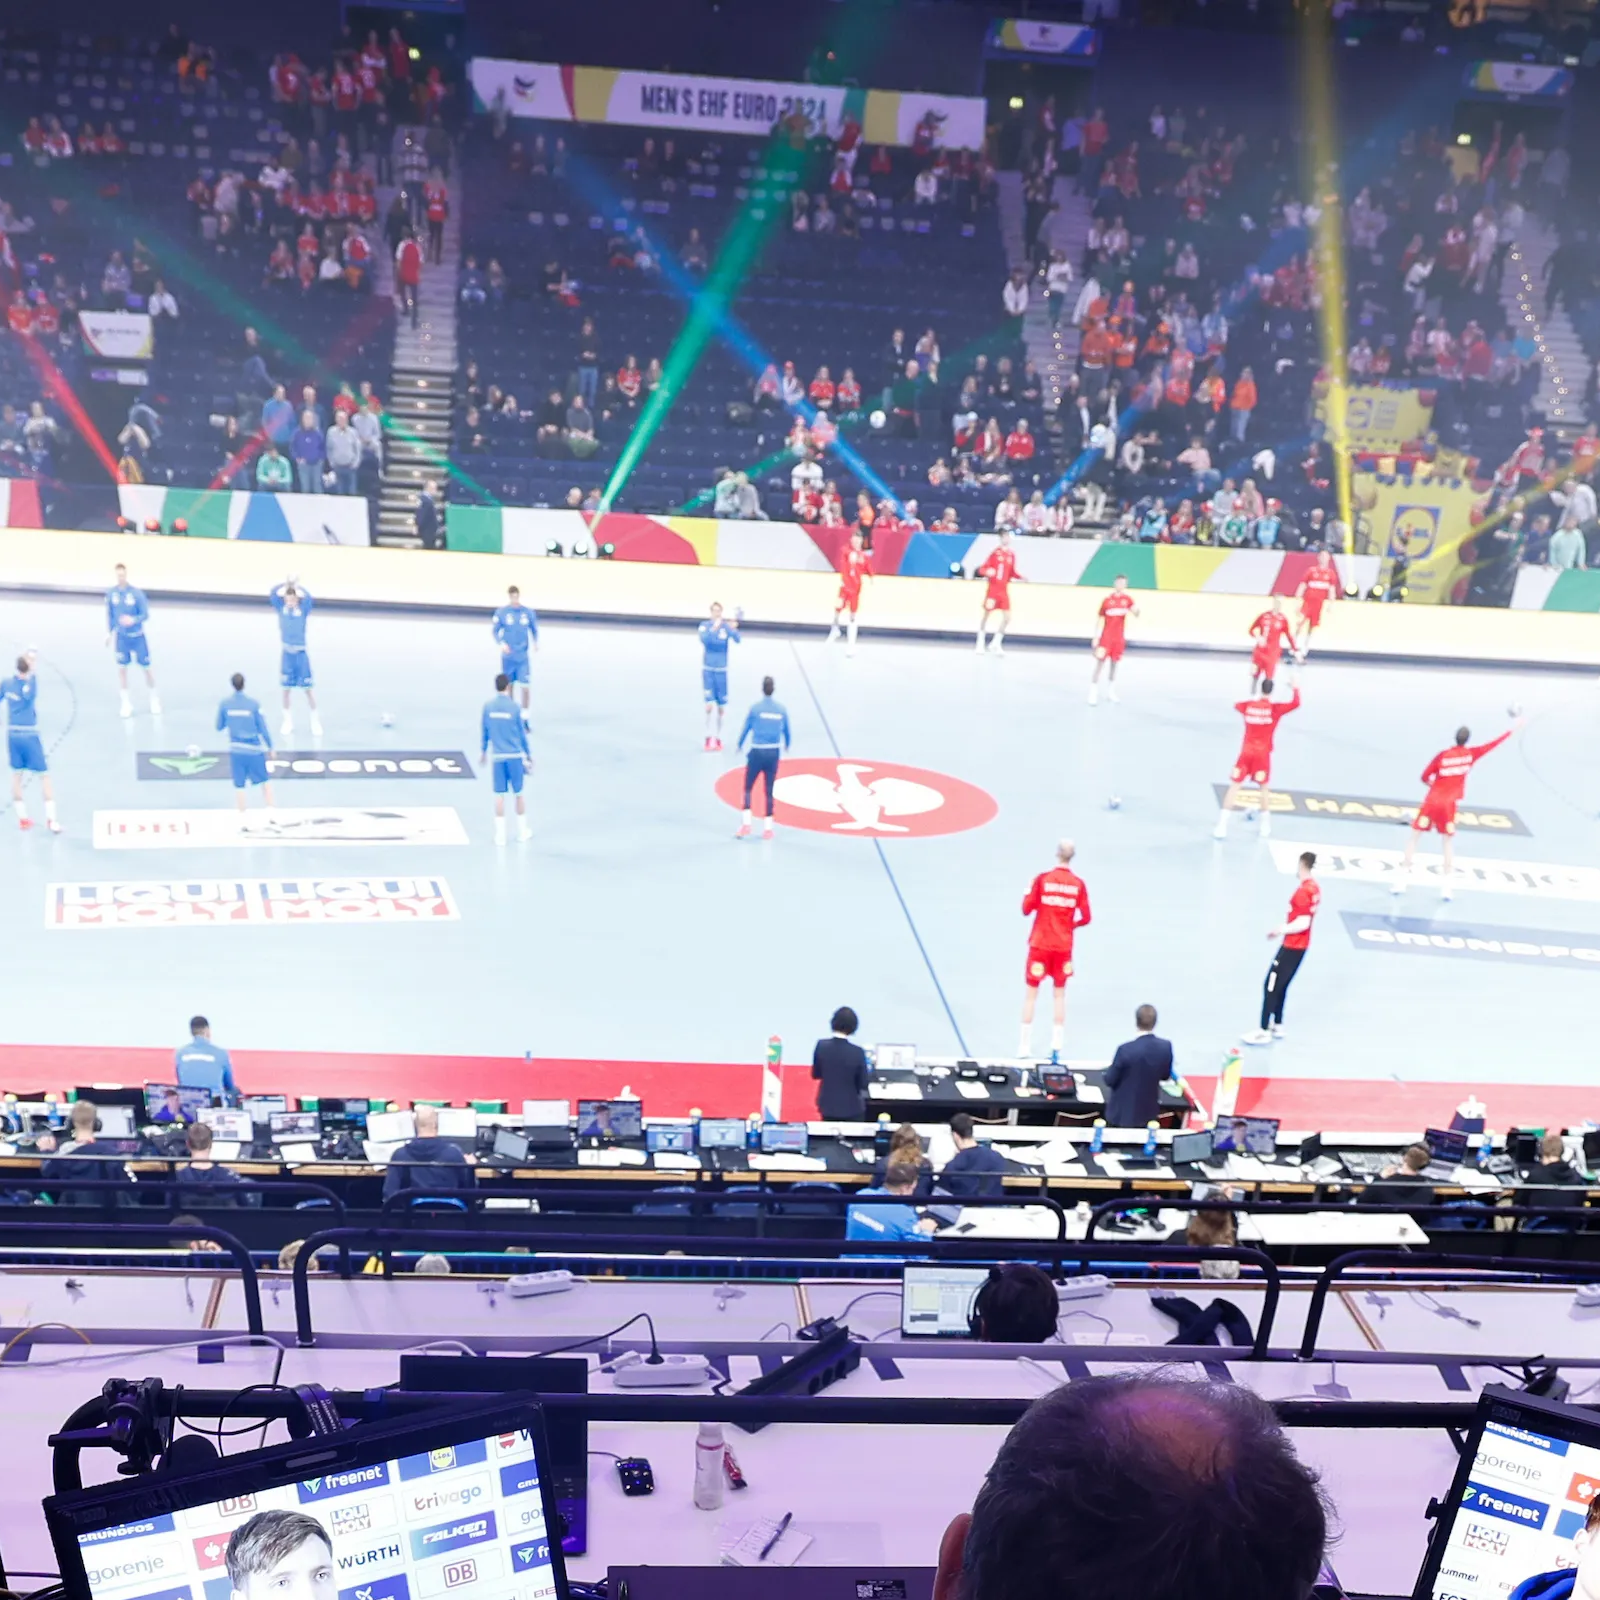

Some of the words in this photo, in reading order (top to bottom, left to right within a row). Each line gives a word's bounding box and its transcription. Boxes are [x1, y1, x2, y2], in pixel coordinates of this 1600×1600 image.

[699, 87, 728, 117] EHF
[733, 92, 775, 122] EURO
[64, 884, 245, 904] LIQUI
[266, 879, 441, 899] LIQUI
[64, 903, 248, 923] MOLY
[270, 899, 449, 919] MOLY
[324, 1465, 383, 1491] freenet
[1474, 1451, 1543, 1481] gorenje
[414, 1484, 482, 1512] trivago
[1477, 1492, 1540, 1523] freenet
[331, 1504, 368, 1524] LIQUI
[333, 1517, 372, 1536] MOLY
[77, 1522, 155, 1544] GRUNDFOS
[422, 1519, 488, 1545] FALKEN
[1468, 1523, 1511, 1544] LIQUI
[337, 1543, 400, 1570] WÜRTH
[1463, 1536, 1508, 1557] MOLY
[87, 1555, 165, 1585] gorenje
[447, 1564, 475, 1584] DB
[1439, 1566, 1479, 1583] ummel
